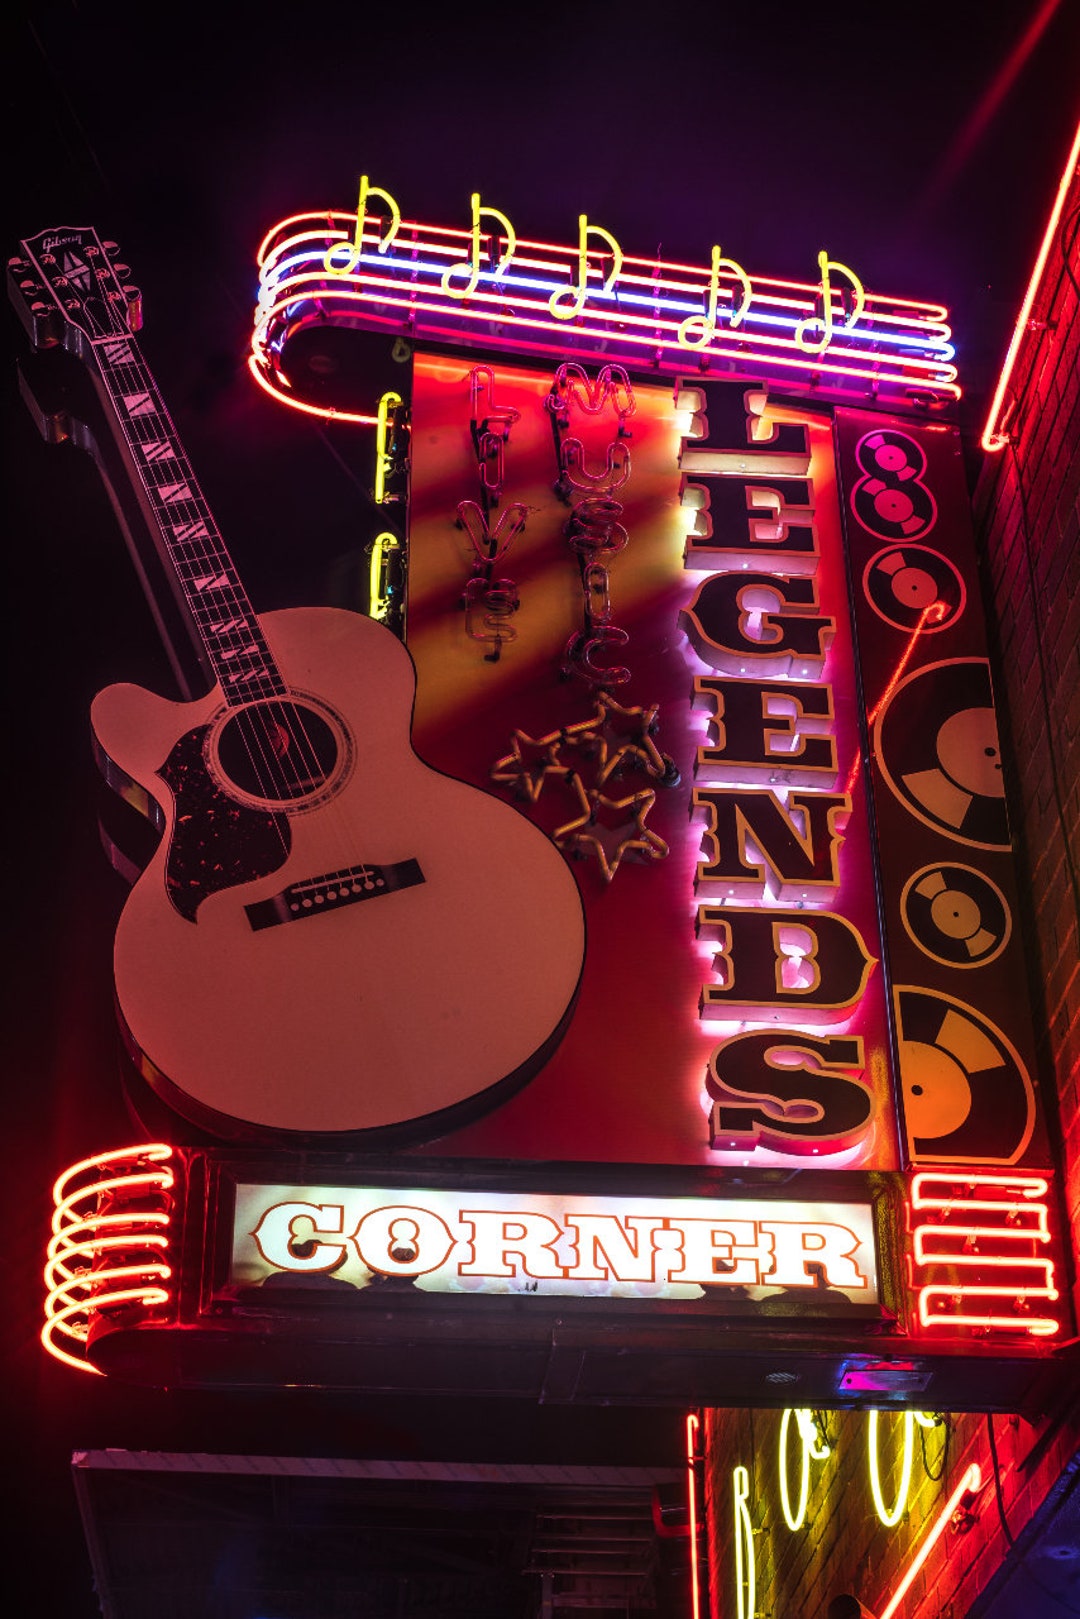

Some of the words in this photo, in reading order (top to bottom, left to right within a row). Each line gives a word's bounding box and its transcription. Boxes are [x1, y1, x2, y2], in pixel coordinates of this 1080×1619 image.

[42, 234, 83, 252] Gibson
[457, 364, 528, 644] LIVE
[544, 362, 637, 686] MUSIC
[677, 378, 879, 1154] LEGENDS
[249, 1201, 869, 1289] CORNER
